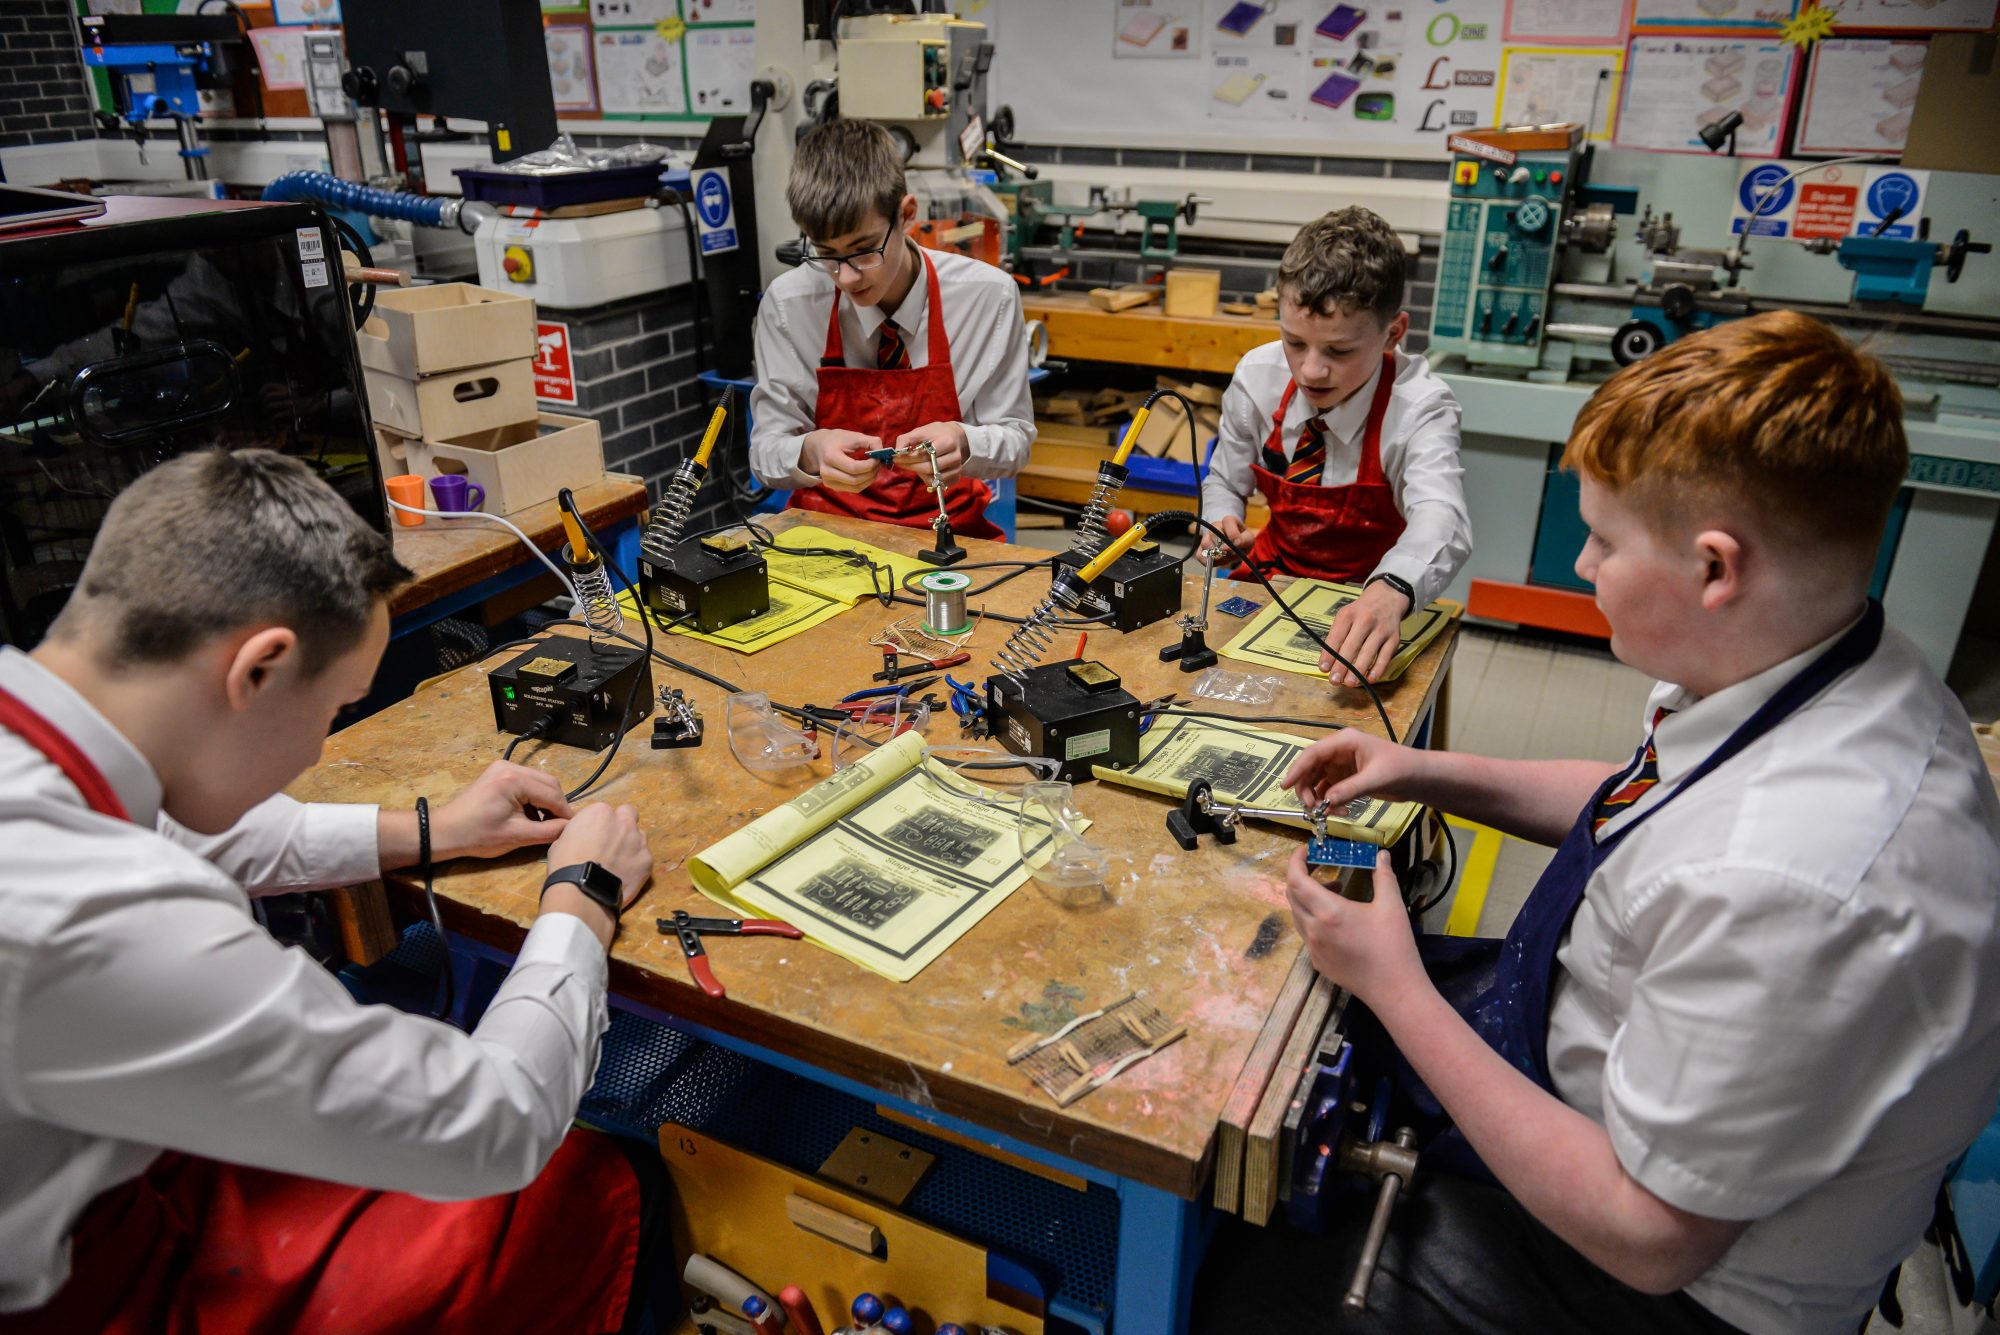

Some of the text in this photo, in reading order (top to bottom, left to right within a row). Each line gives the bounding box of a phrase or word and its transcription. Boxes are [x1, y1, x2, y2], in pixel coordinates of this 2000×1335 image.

[966, 800, 990, 813] Stage
[885, 856, 910, 871] Stage
[680, 1137, 697, 1155] 13
